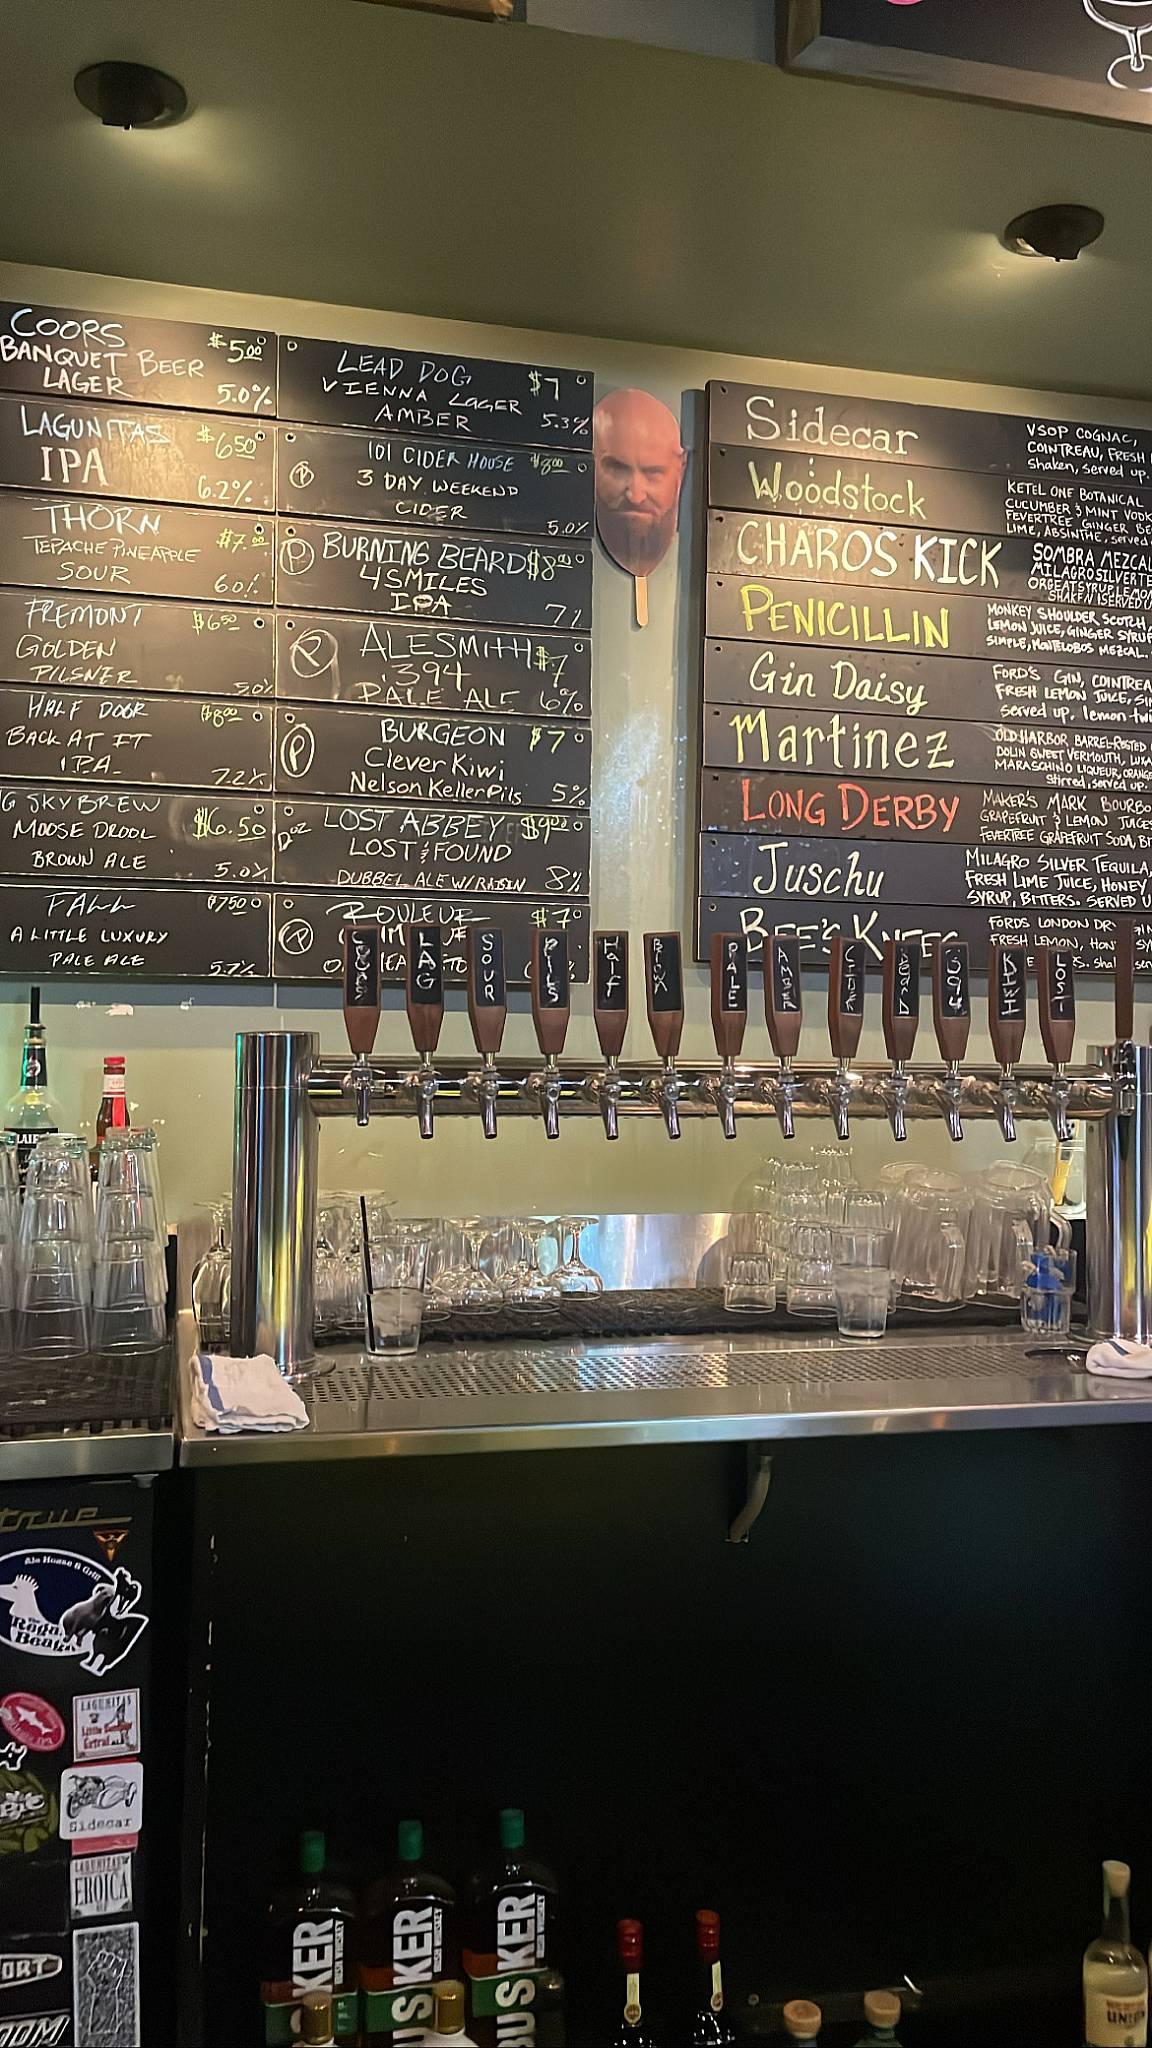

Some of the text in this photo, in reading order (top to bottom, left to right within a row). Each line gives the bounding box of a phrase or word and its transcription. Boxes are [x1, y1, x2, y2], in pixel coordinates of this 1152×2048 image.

[11, 309, 125, 347] COORS
[0, 335, 204, 377] BANQUET BEER
[337, 351, 472, 386] LEAD DOG
[43, 367, 133, 397] LAGER
[322, 377, 427, 402] VIENNA
[529, 370, 559, 400] $7
[217, 384, 272, 412] 5.0%
[21, 405, 170, 446] LAGUNITAS
[374, 403, 472, 432] AMBER
[541, 414, 589, 434] 5.3%
[745, 395, 919, 455] Sidecar
[1027, 423, 1137, 446] VSOP COGNAC,
[368, 441, 514, 472] 101 CIDER HOUSE
[1028, 441, 1145, 463] COINTREAU, FRESH
[41, 446, 109, 485] IPA
[198, 475, 253, 506] 6.2%
[357, 469, 518, 497] 3 DAY WEEKEND
[748, 462, 926, 519] Woodstock
[1008, 479, 1144, 507] KETEL ONE BOTANICAL
[32, 504, 161, 534] THORN
[396, 501, 467, 521] CIDER
[1005, 498, 1118, 520] CUCUMBER MINT
[547, 521, 588, 535] 5.0%
[1006, 510, 1128, 534] FEVERTREE GINGER
[1007, 523, 1040, 538] LIME,
[22, 536, 202, 562] TEPACHE PINEAPPLE
[323, 532, 526, 575] BURNING BEARD
[737, 520, 1002, 588] CHAROS KICK
[1033, 543, 1095, 567] SOMBRA
[57, 562, 131, 584] SOUR
[1028, 577, 1077, 590] ORGEAT
[1030, 562, 1137, 585] MILAGRO SILVER
[24, 598, 151, 629] FREMONT
[740, 584, 949, 648] PENICILLIN
[987, 603, 1100, 625] MONKEY SHOULDER
[988, 618, 1113, 640] LEMON JUICE, GINGER
[16, 635, 116, 659] GOLDEN
[360, 622, 532, 669] ALESMITH
[30, 665, 138, 684] PILSNER
[749, 650, 928, 716] Gin Daisy
[992, 664, 1085, 688] FORD'S GIN,
[355, 682, 520, 712] PALE ALE
[995, 684, 1037, 700] FRESH
[1044, 688, 1086, 701] LEMON
[29, 695, 149, 720] HALF DOOR
[1001, 703, 1126, 721] served lemon
[6, 726, 151, 751] BACK AT IT
[381, 718, 505, 747] BURGEON
[529, 726, 565, 753] $7
[729, 708, 955, 770] Martinez
[365, 747, 505, 782] Clever Kiwi
[997, 746, 1026, 758] DOLIN
[1030, 748, 1065, 760] SWEET
[995, 760, 1072, 773] MARASCHINO
[350, 772, 422, 796] Nelson
[551, 783, 587, 806] 5%
[27, 793, 161, 814] SKY BREW
[742, 778, 959, 832] LONG DERBY
[982, 789, 1086, 813] MAKER'S MARK
[12, 820, 156, 840] MOOSE DROOL
[324, 807, 505, 842] LOST ABBEY
[980, 809, 1108, 828] GRAPEFRUIT LEMON
[979, 826, 1103, 846] FEVERTREE GRAPEFRUIT
[32, 848, 147, 870] BROWN ALE
[349, 840, 512, 863] LOST FOUND
[966, 847, 1088, 872] MILAGRO SILVER
[337, 870, 449, 887] DUBBEL ALE
[545, 866, 582, 892] 8%
[753, 842, 885, 897] Juschu
[965, 870, 1147, 895] FRESH LIME JUICE, HONEY
[1087, 895, 1136, 908] SERVED
[11, 927, 168, 944] A LITTLE LUXURY
[988, 916, 1090, 930] FORDS LONDON
[990, 933, 1083, 951] FRESH LEMON,
[49, 953, 145, 967] PALE ALE
[416, 932, 436, 989] LAG
[481, 934, 495, 1001] SOUR
[726, 942, 740, 1007] PALE
[1051, 954, 1071, 1012] LOST
[75, 1872, 128, 1905] EROICA
